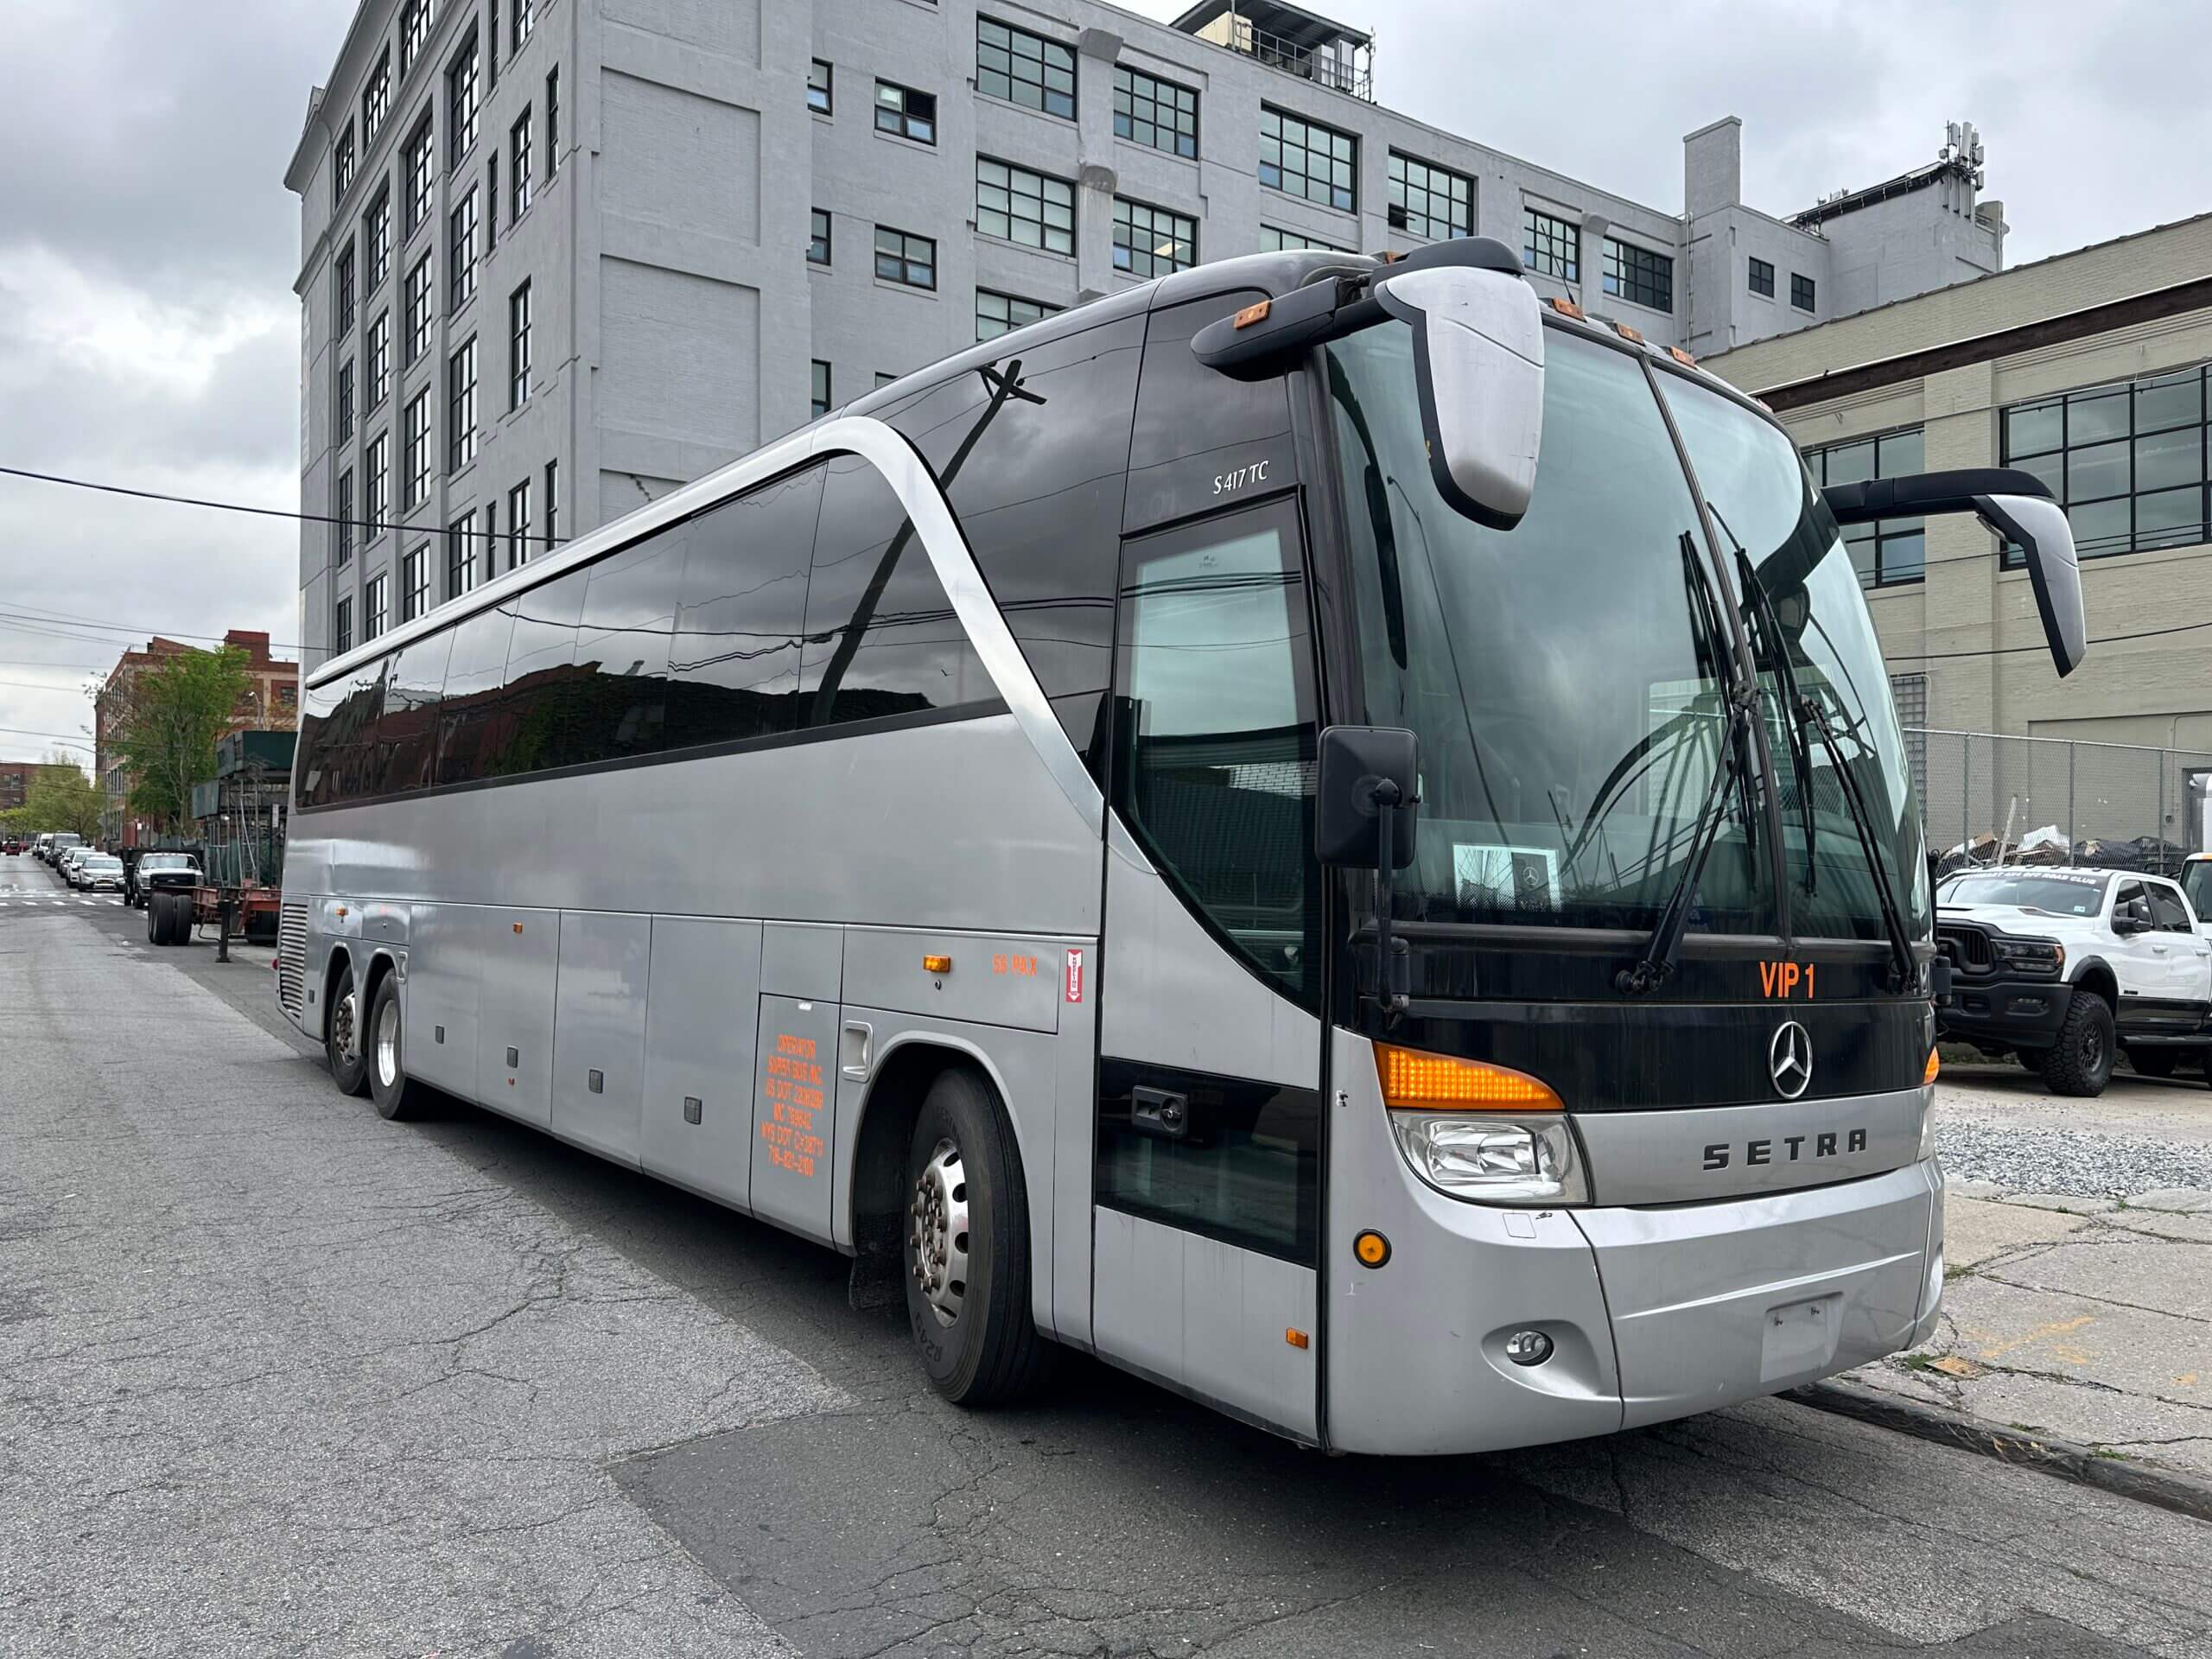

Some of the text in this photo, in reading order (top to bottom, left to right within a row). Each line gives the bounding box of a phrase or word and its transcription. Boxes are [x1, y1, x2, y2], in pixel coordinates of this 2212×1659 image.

[1249, 460, 1269, 483] TC
[2069, 875, 2097, 885] CLUB
[1011, 953, 1038, 976] PAX
[1758, 961, 1815, 999] VIP 1
[777, 1081, 793, 1101] DOT
[777, 1125, 793, 1147] DOT
[1702, 1128, 1867, 1171] SETRA
